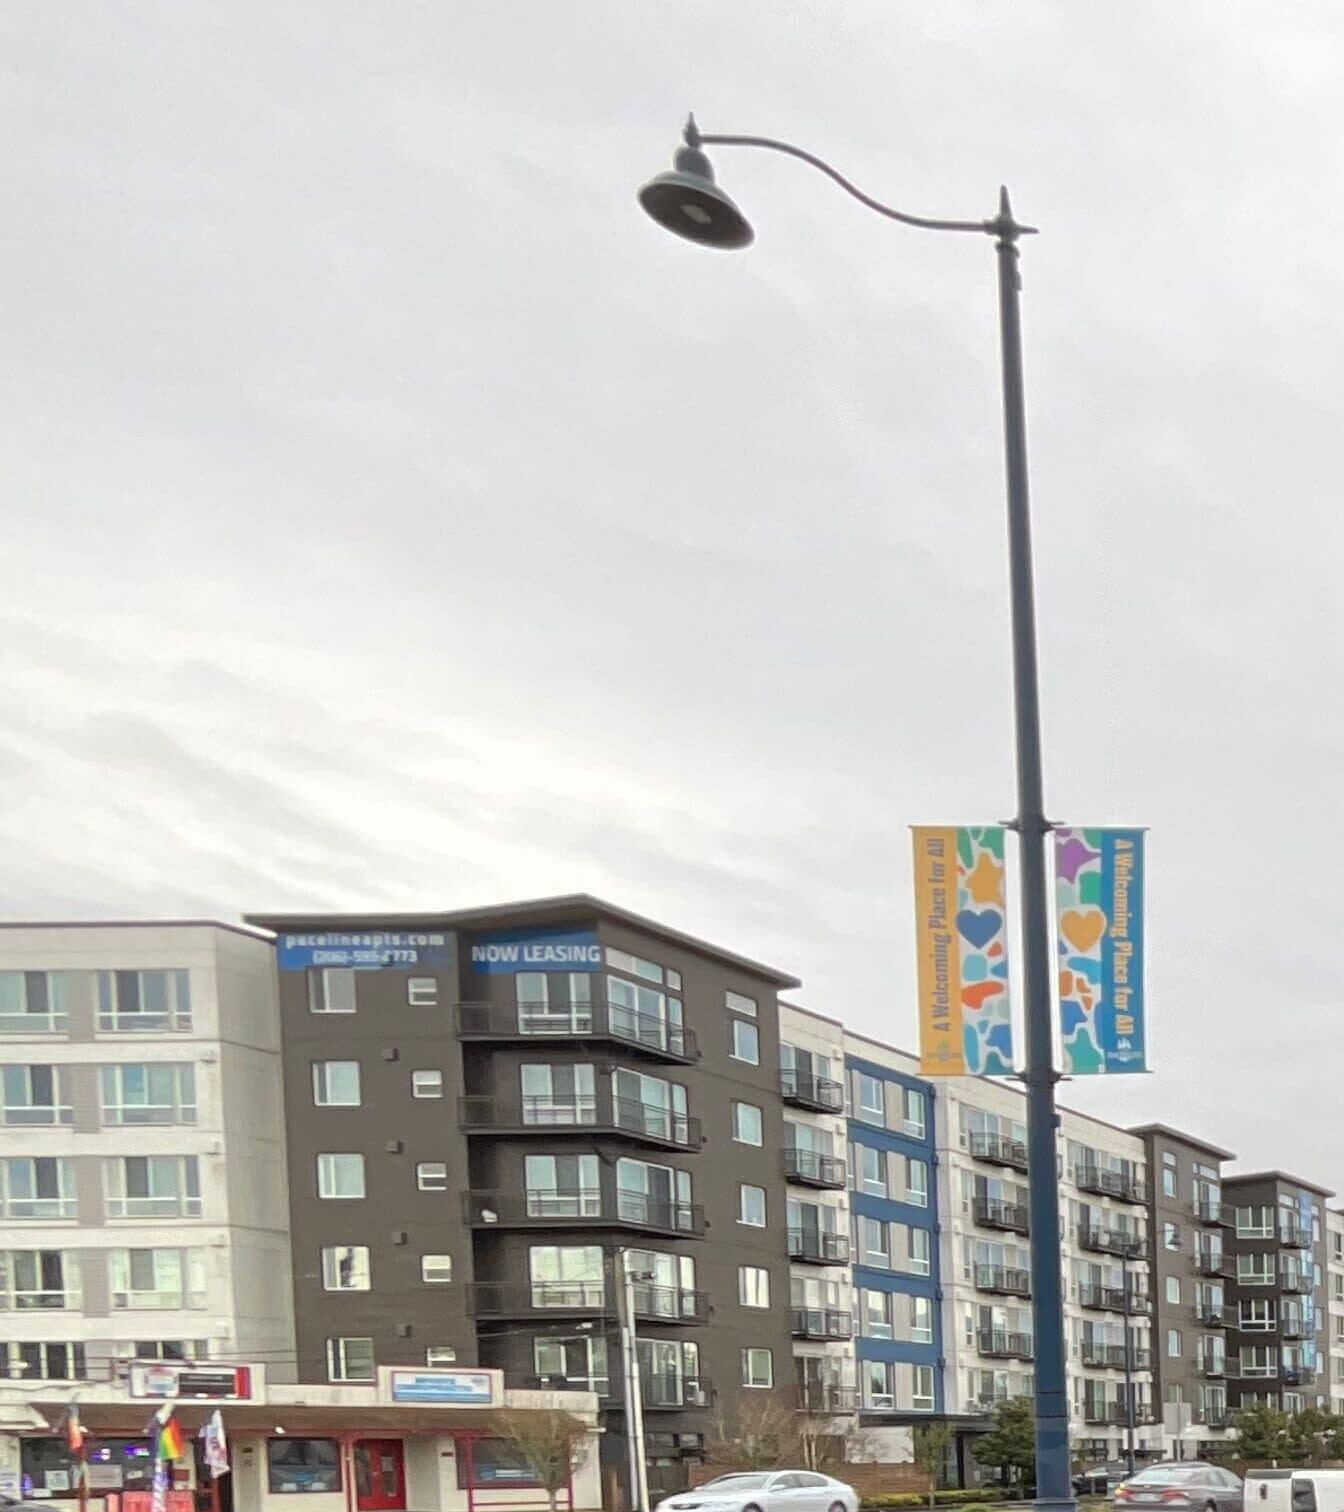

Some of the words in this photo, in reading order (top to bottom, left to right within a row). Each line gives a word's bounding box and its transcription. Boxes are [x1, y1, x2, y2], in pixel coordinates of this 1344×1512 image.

[927, 838, 945, 857] All
[1115, 839, 1134, 850] A
[928, 861, 945, 883] for
[1110, 852, 1134, 938] Welcoming
[929, 888, 947, 929] Place
[472, 945, 519, 962] NOW
[523, 945, 600, 962] LEASING
[1114, 942, 1133, 983] Place
[930, 933, 951, 1018] Welcoming
[1114, 986, 1133, 1011] for
[933, 1022, 951, 1032] A
[1116, 1014, 1135, 1034] All
